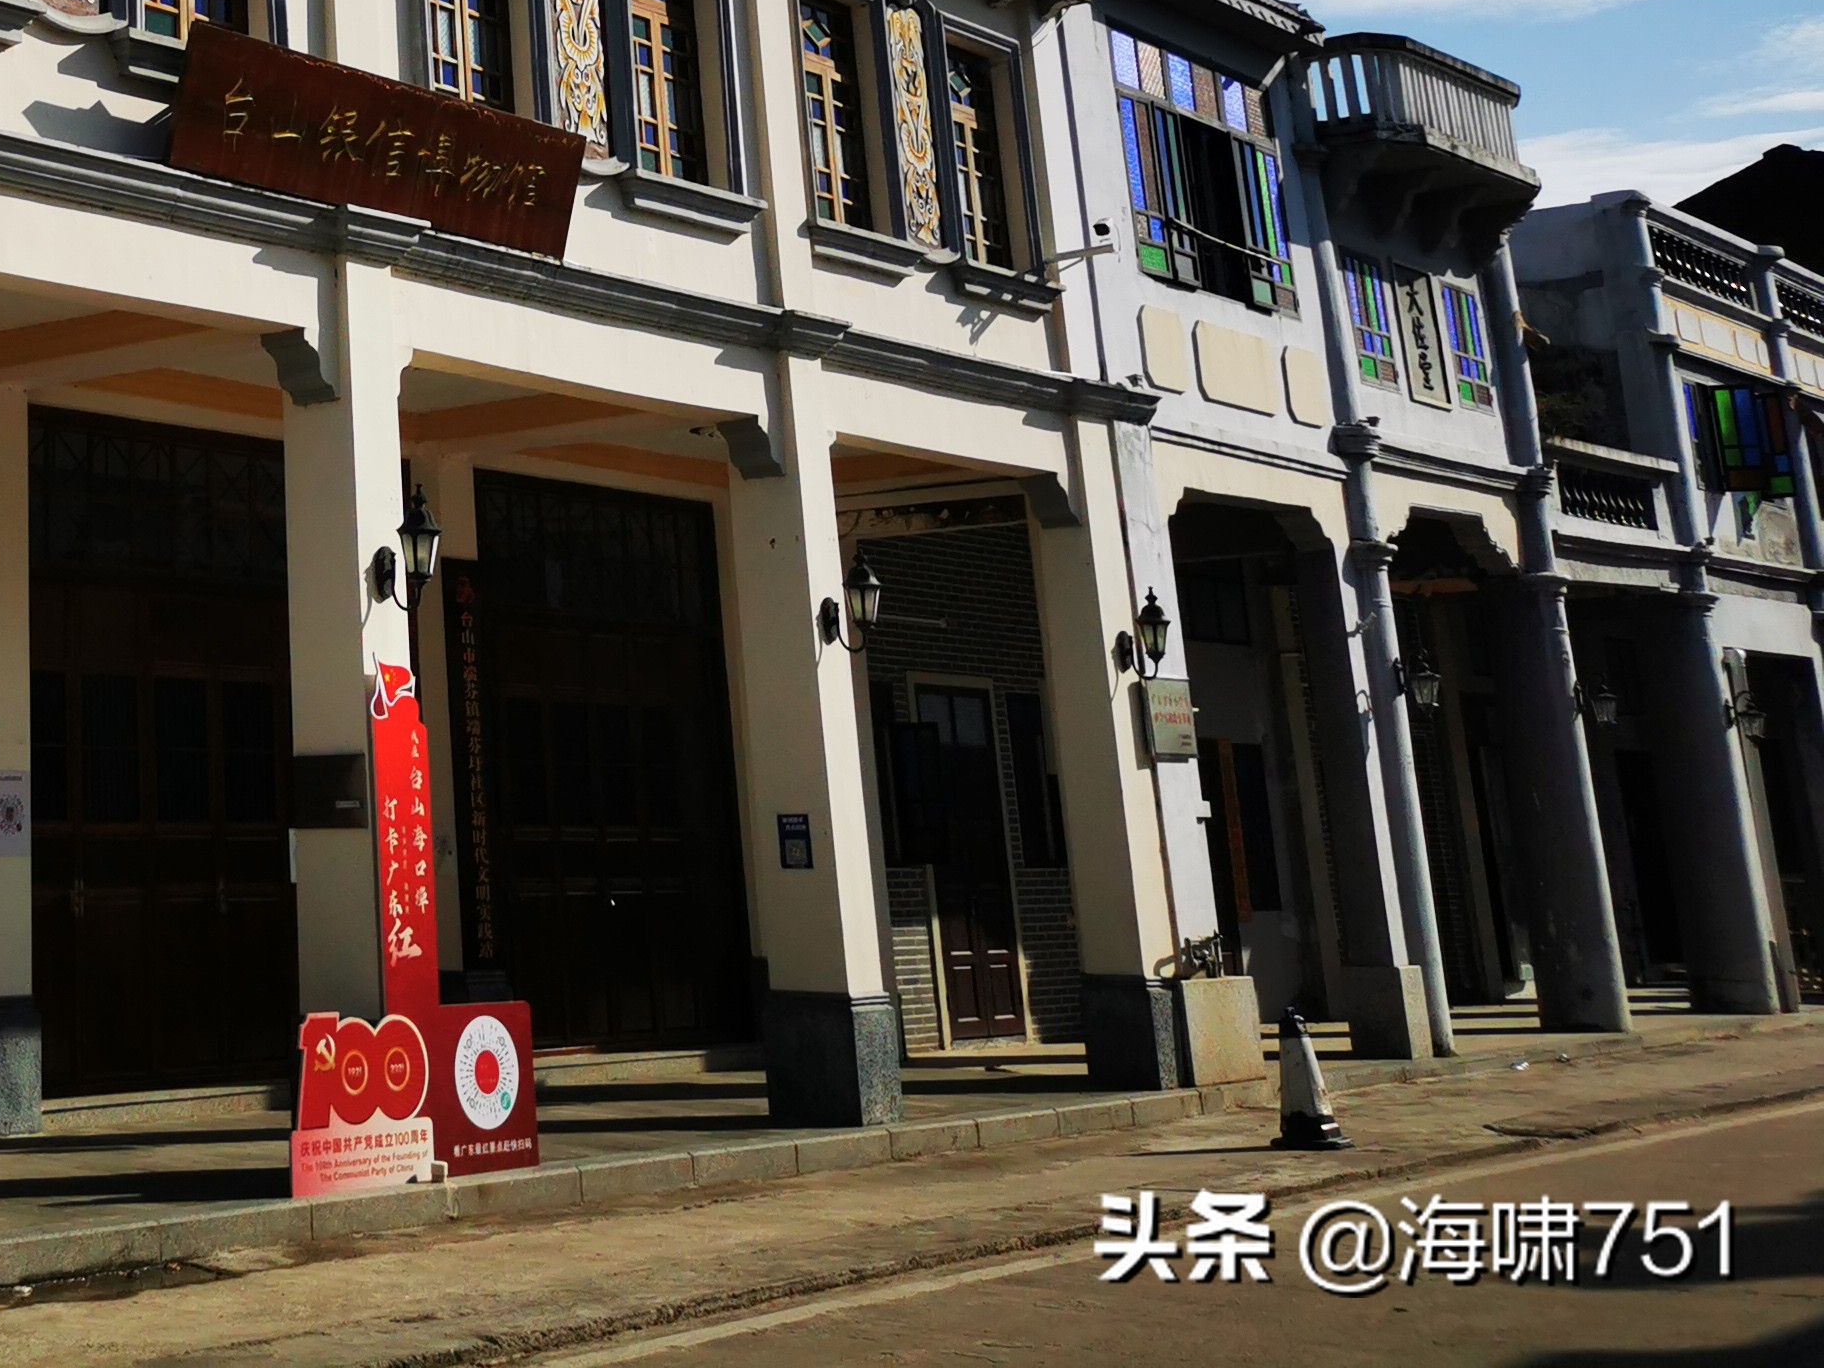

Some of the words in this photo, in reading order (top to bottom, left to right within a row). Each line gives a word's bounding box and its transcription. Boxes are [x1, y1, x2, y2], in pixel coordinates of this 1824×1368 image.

[300, 1129, 429, 1158] 庆祝中国共产党成立100周年
[334, 1157, 372, 1169] Anniversary
[381, 1153, 391, 1163] the
[392, 1150, 421, 1163] Founding
[320, 1172, 332, 1182] The
[333, 1169, 370, 1181] Communist
[371, 1166, 387, 1177] Party
[396, 1163, 414, 1173] China
